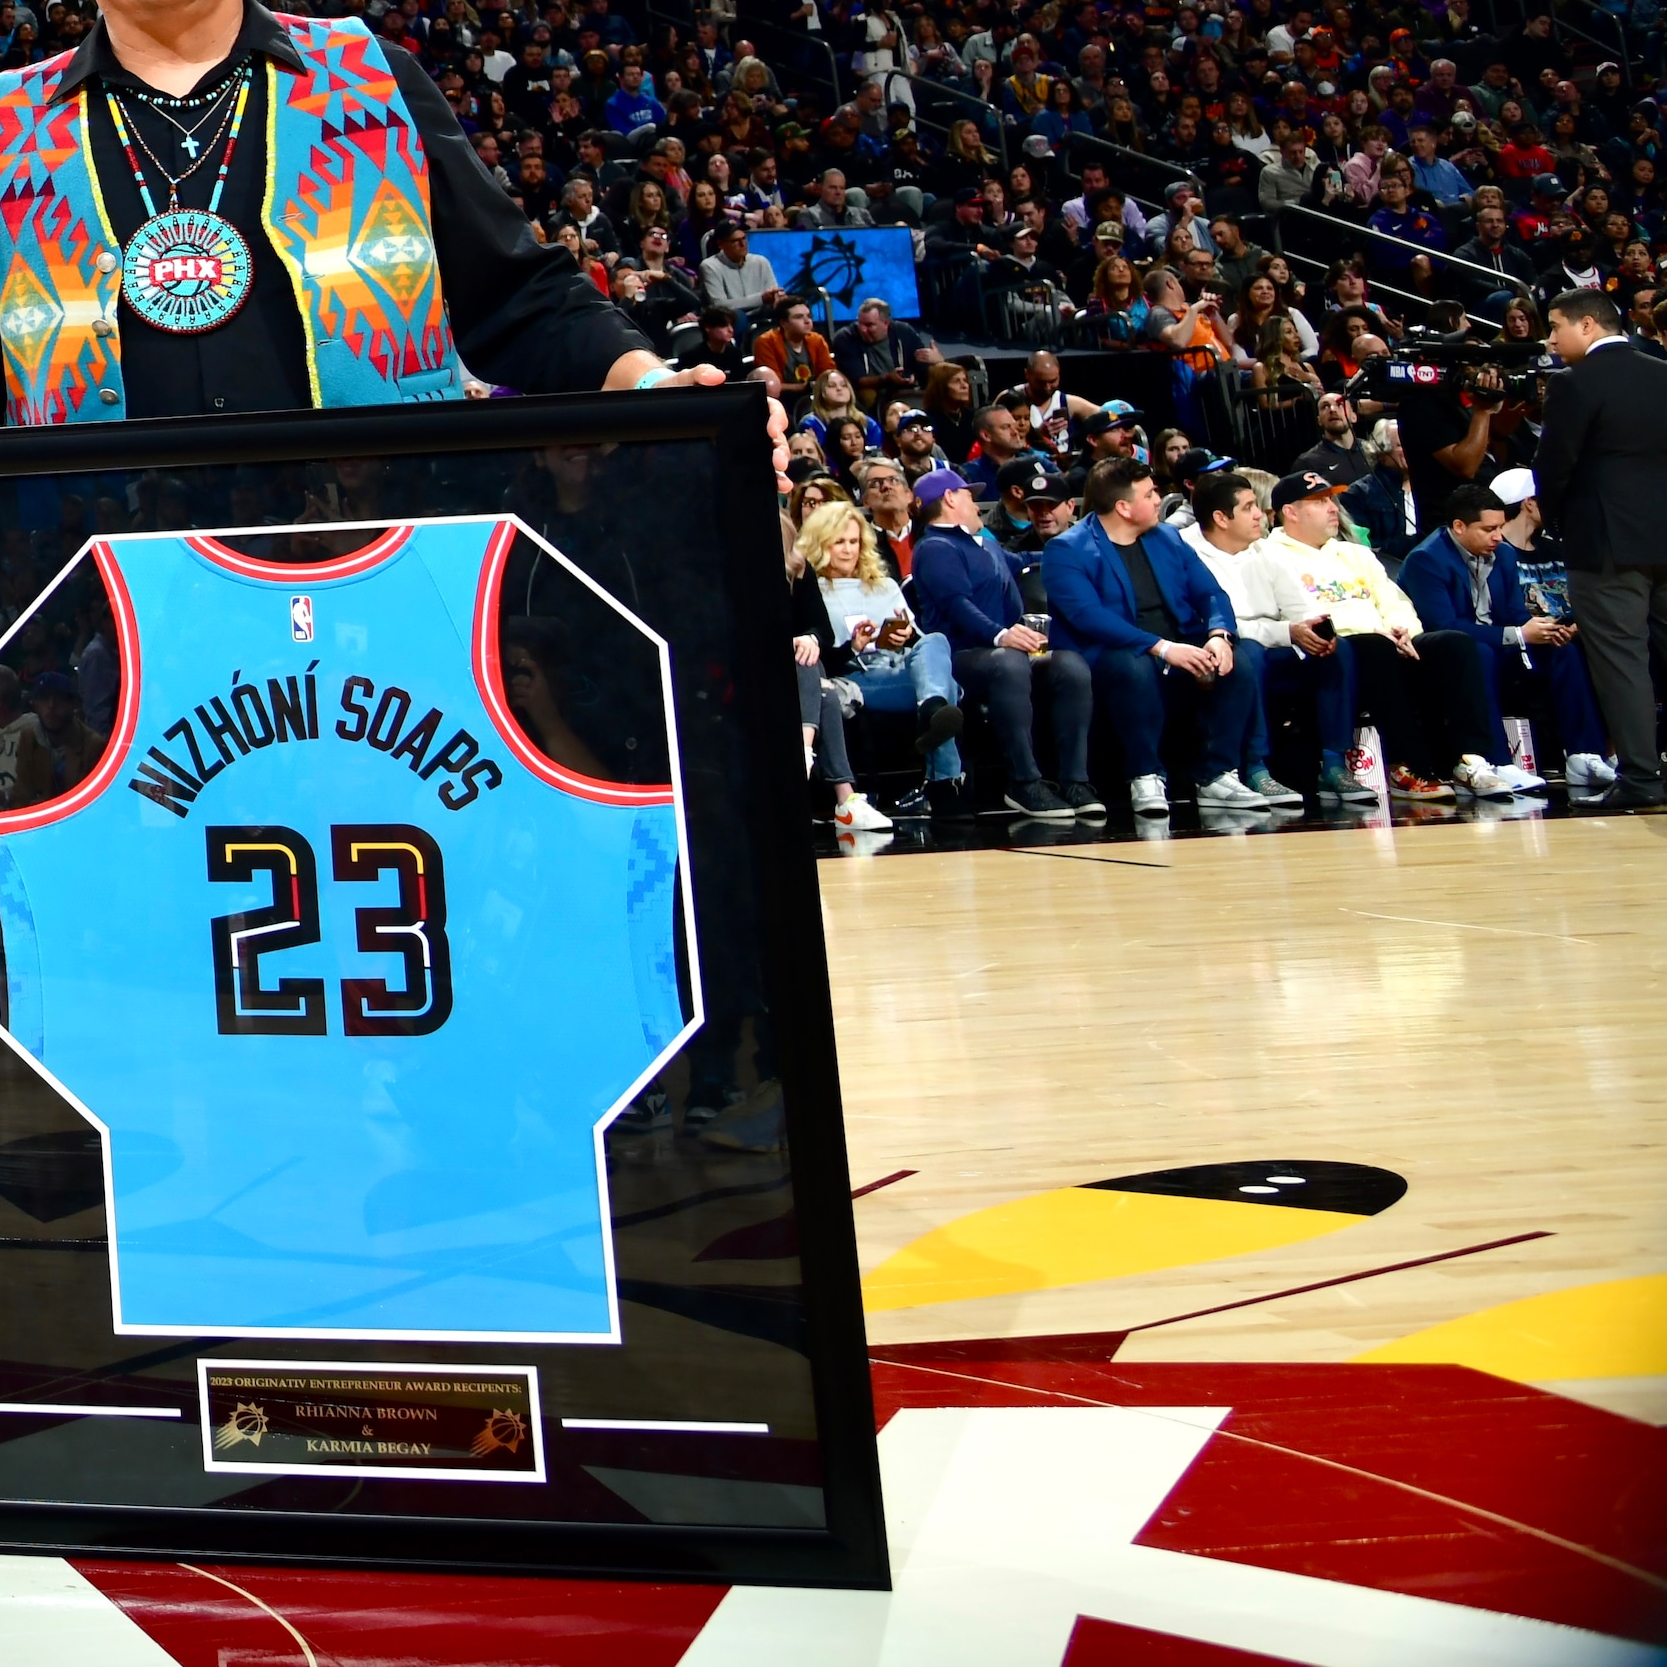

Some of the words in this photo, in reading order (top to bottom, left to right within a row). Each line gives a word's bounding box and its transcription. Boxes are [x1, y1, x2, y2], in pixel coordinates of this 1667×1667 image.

[153, 258, 217, 282] PHX
[1389, 365, 1407, 379] NBA
[127, 659, 321, 819] NIZHÓNÍ
[335, 675, 504, 812] SOAPS
[204, 823, 455, 1037] 23
[210, 1376, 233, 1388] 2023
[234, 1377, 307, 1390] ORIGINATIV
[309, 1378, 402, 1392] ENTREPRENEUR
[405, 1380, 452, 1393] AWARD
[454, 1381, 523, 1395] RECIPENTS:
[294, 1404, 375, 1421] RHIANNA
[376, 1406, 438, 1422] BROWN
[361, 1423, 375, 1437] &
[306, 1440, 374, 1455] KARMIA
[376, 1441, 432, 1456] BEGAY
